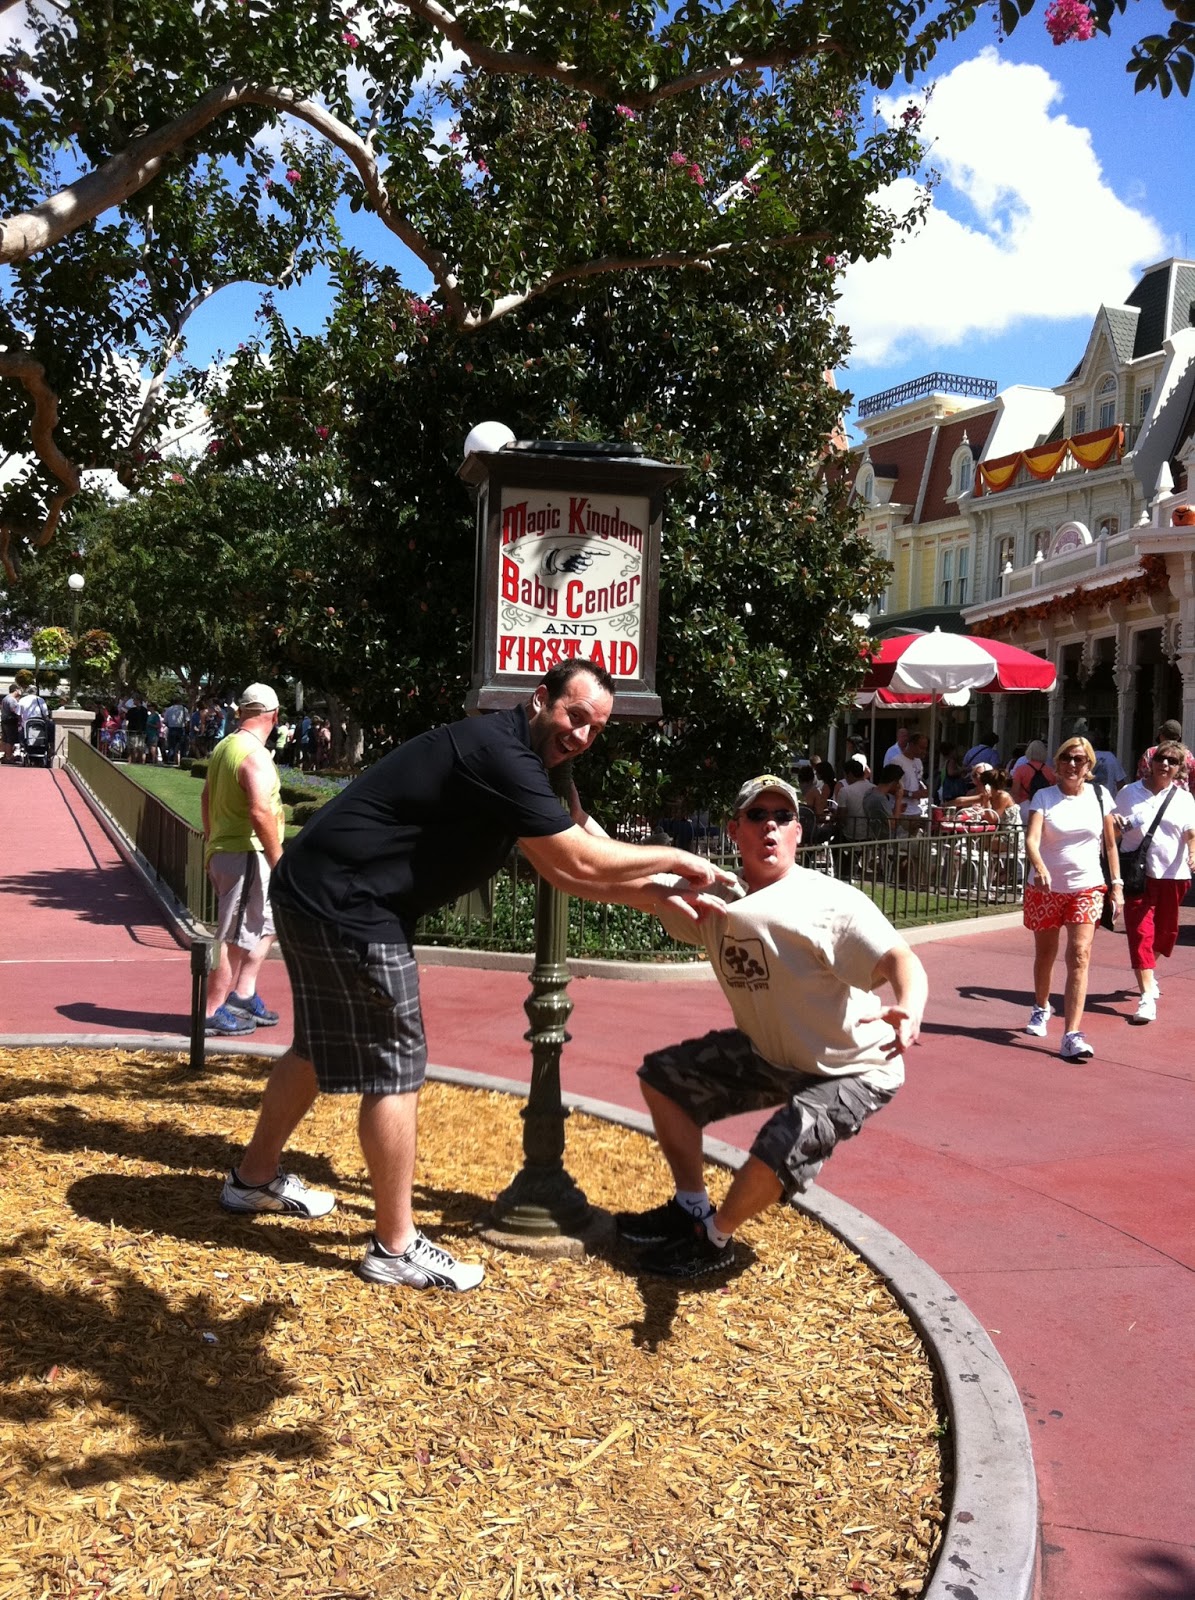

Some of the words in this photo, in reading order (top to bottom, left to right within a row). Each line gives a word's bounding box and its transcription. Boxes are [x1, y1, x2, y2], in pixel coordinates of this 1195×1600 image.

[502, 501, 560, 545] Magic
[568, 497, 643, 552] Kingdom
[501, 553, 558, 616] Baby
[566, 574, 640, 619] Center
[542, 623, 598, 636] AND
[498, 635, 582, 672] FIRST
[589, 639, 638, 675] AID
